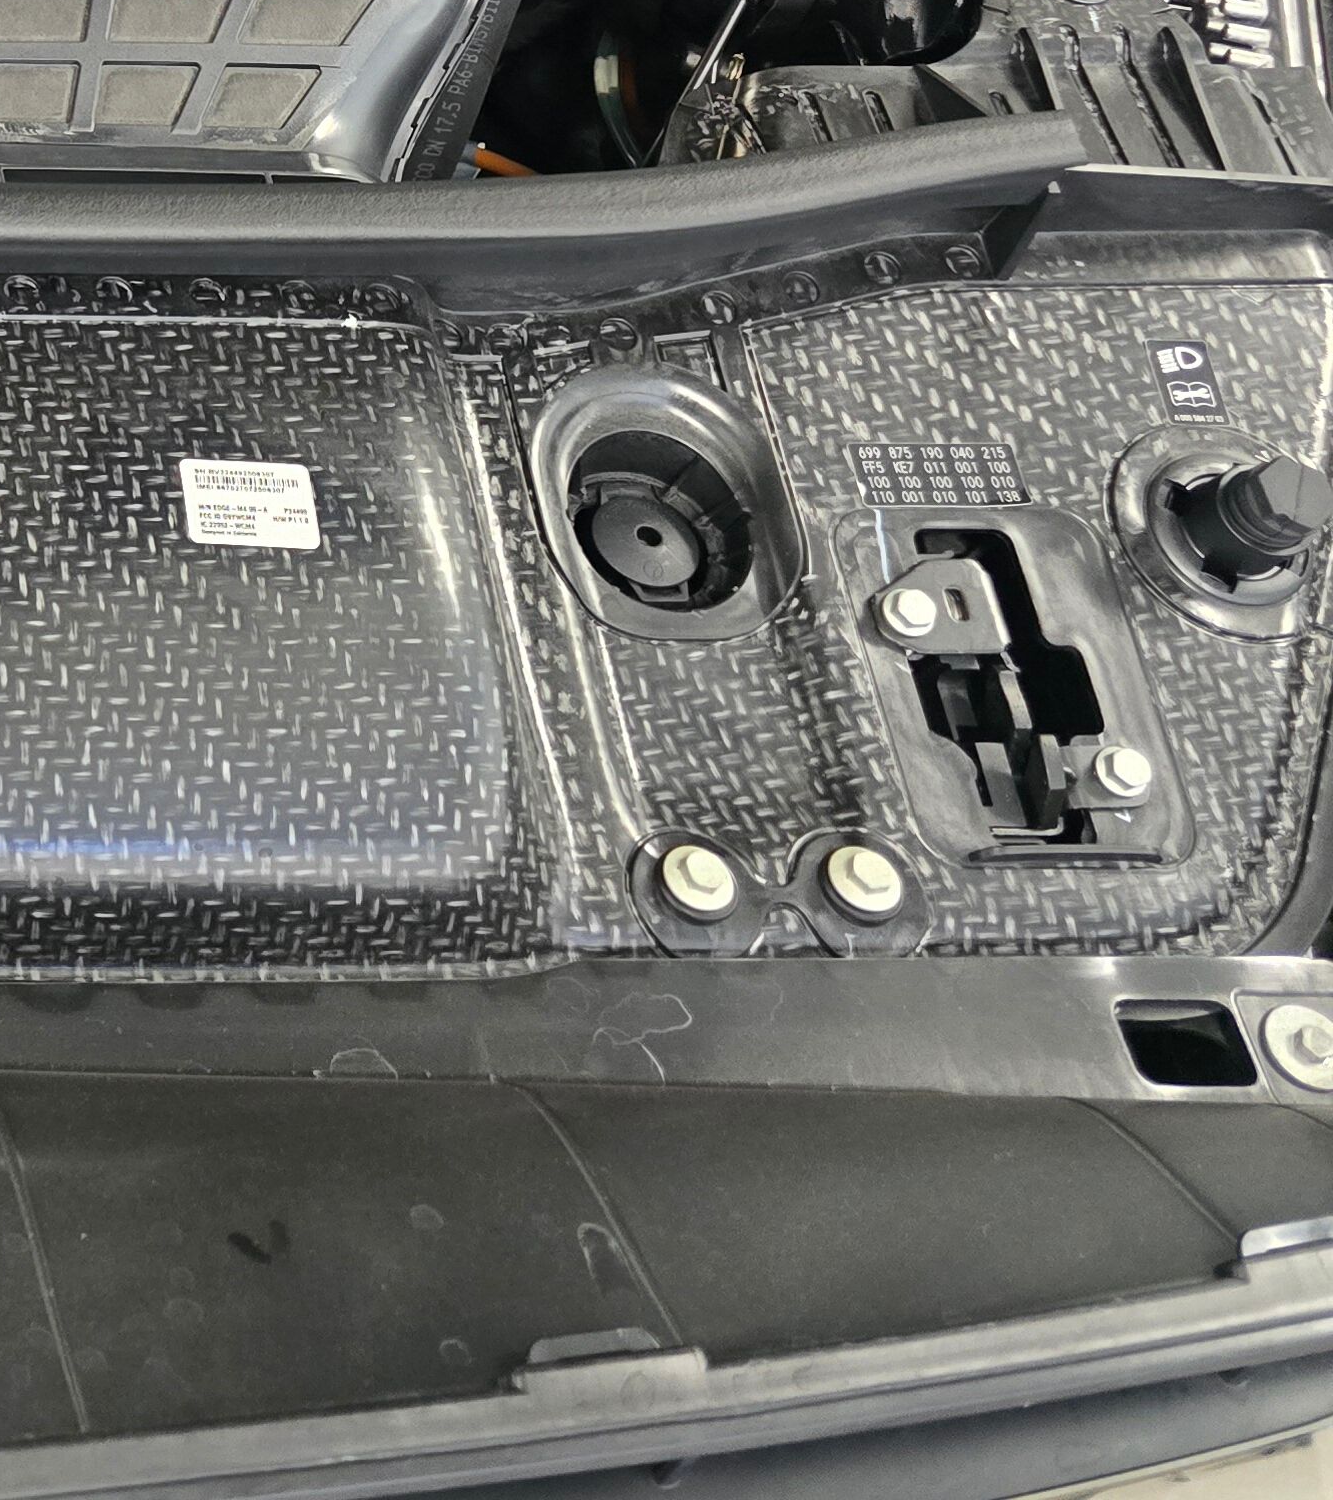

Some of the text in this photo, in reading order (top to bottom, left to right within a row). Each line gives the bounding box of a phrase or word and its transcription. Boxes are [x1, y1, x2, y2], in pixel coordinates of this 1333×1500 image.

[423, 139, 447, 157] DN
[412, 162, 436, 181] CO
[858, 446, 1006, 459] 699 875 190 040 215
[862, 461, 1010, 474] FF5 KE7 011 001 100
[867, 476, 1015, 489] 100 100 100 100 010
[872, 491, 1021, 503] 110 001 010 101 138
